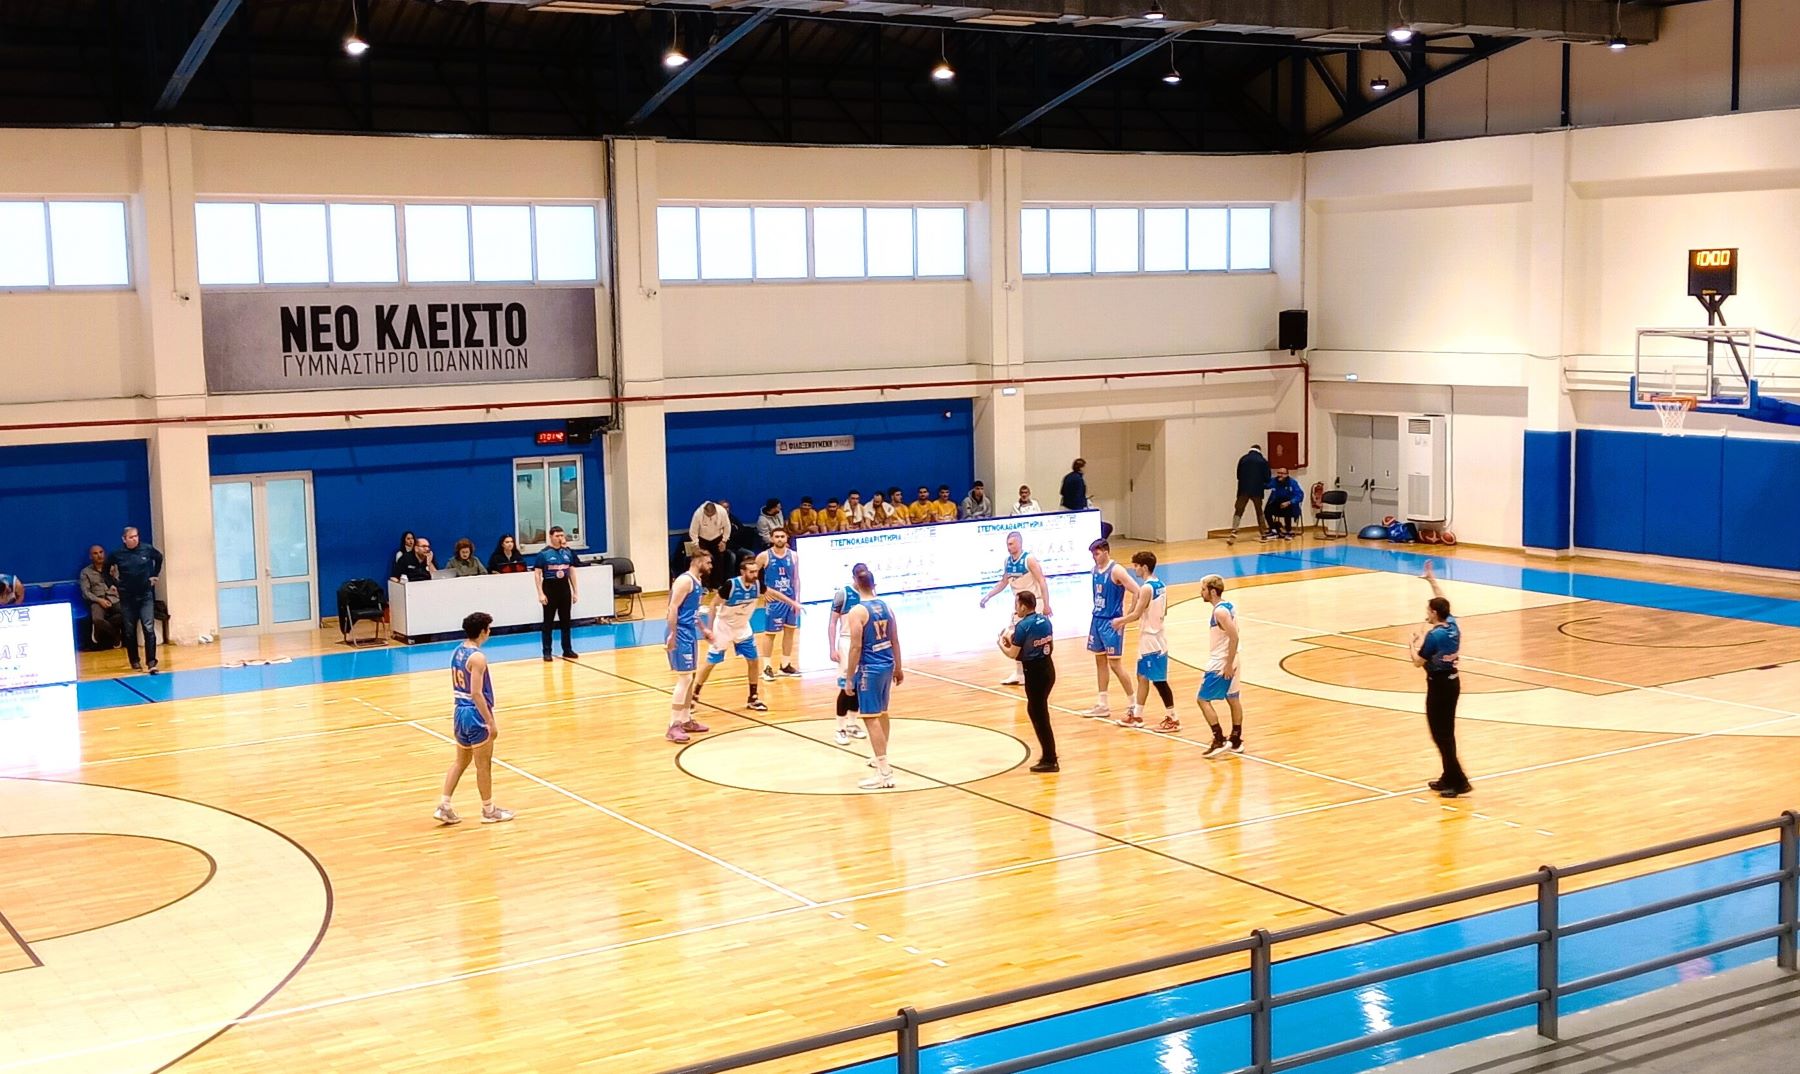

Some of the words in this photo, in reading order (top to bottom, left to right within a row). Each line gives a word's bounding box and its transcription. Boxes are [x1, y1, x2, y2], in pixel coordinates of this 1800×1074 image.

[280, 304, 360, 353] ΝΕΟ
[375, 302, 527, 350] ΚΛΕΙΣΤΟ
[283, 350, 419, 377] ΓΥΜΝΑΣΤΗΡΙΟ
[427, 348, 528, 373] ΙΩΑΝΝΙΝΩΝ
